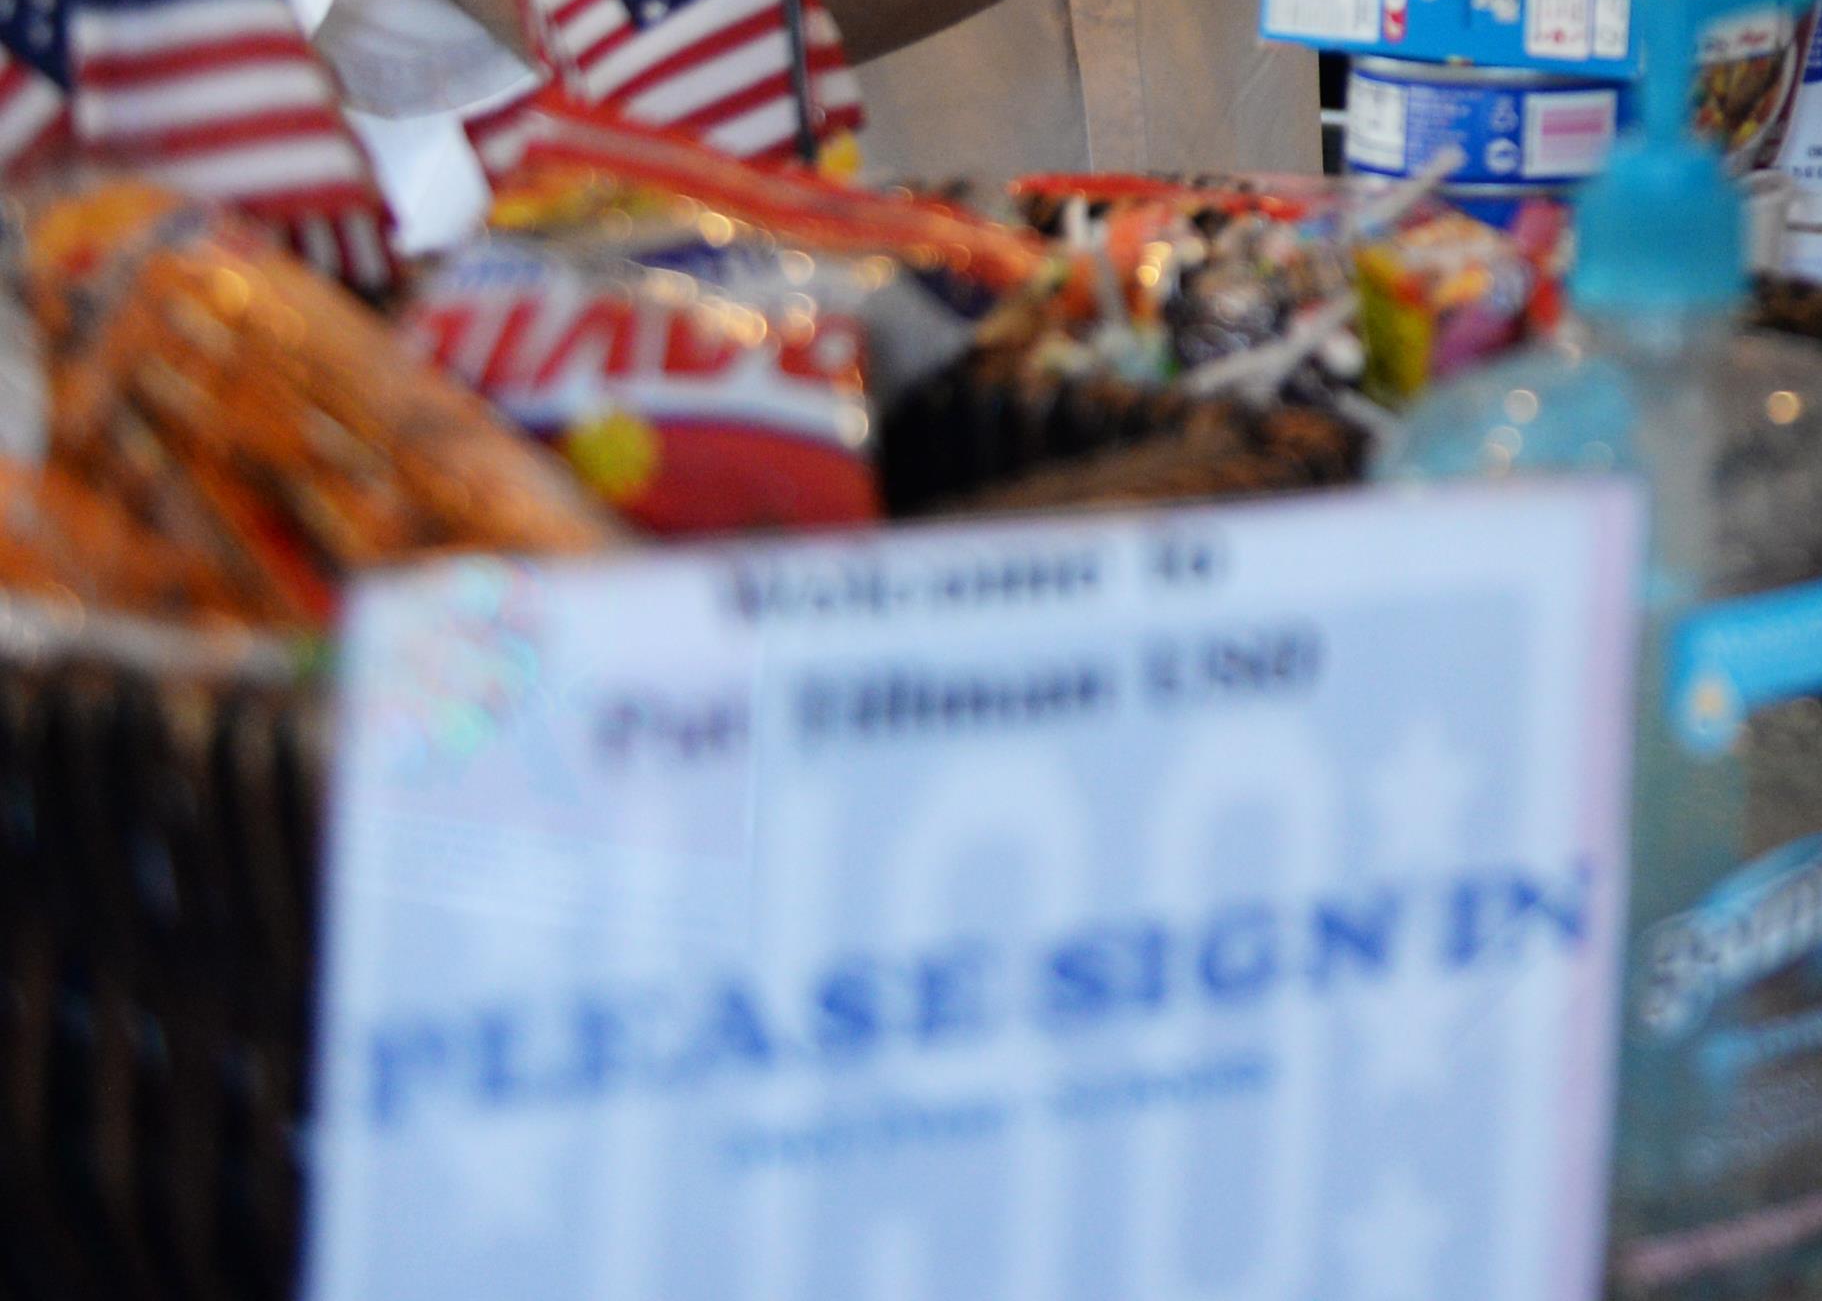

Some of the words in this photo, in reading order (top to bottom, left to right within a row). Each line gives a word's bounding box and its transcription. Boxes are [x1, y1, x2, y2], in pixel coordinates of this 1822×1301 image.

[366, 928, 996, 1128] PLEASE
[1040, 884, 1405, 1022] SIGN
[1442, 853, 1596, 976] IN
